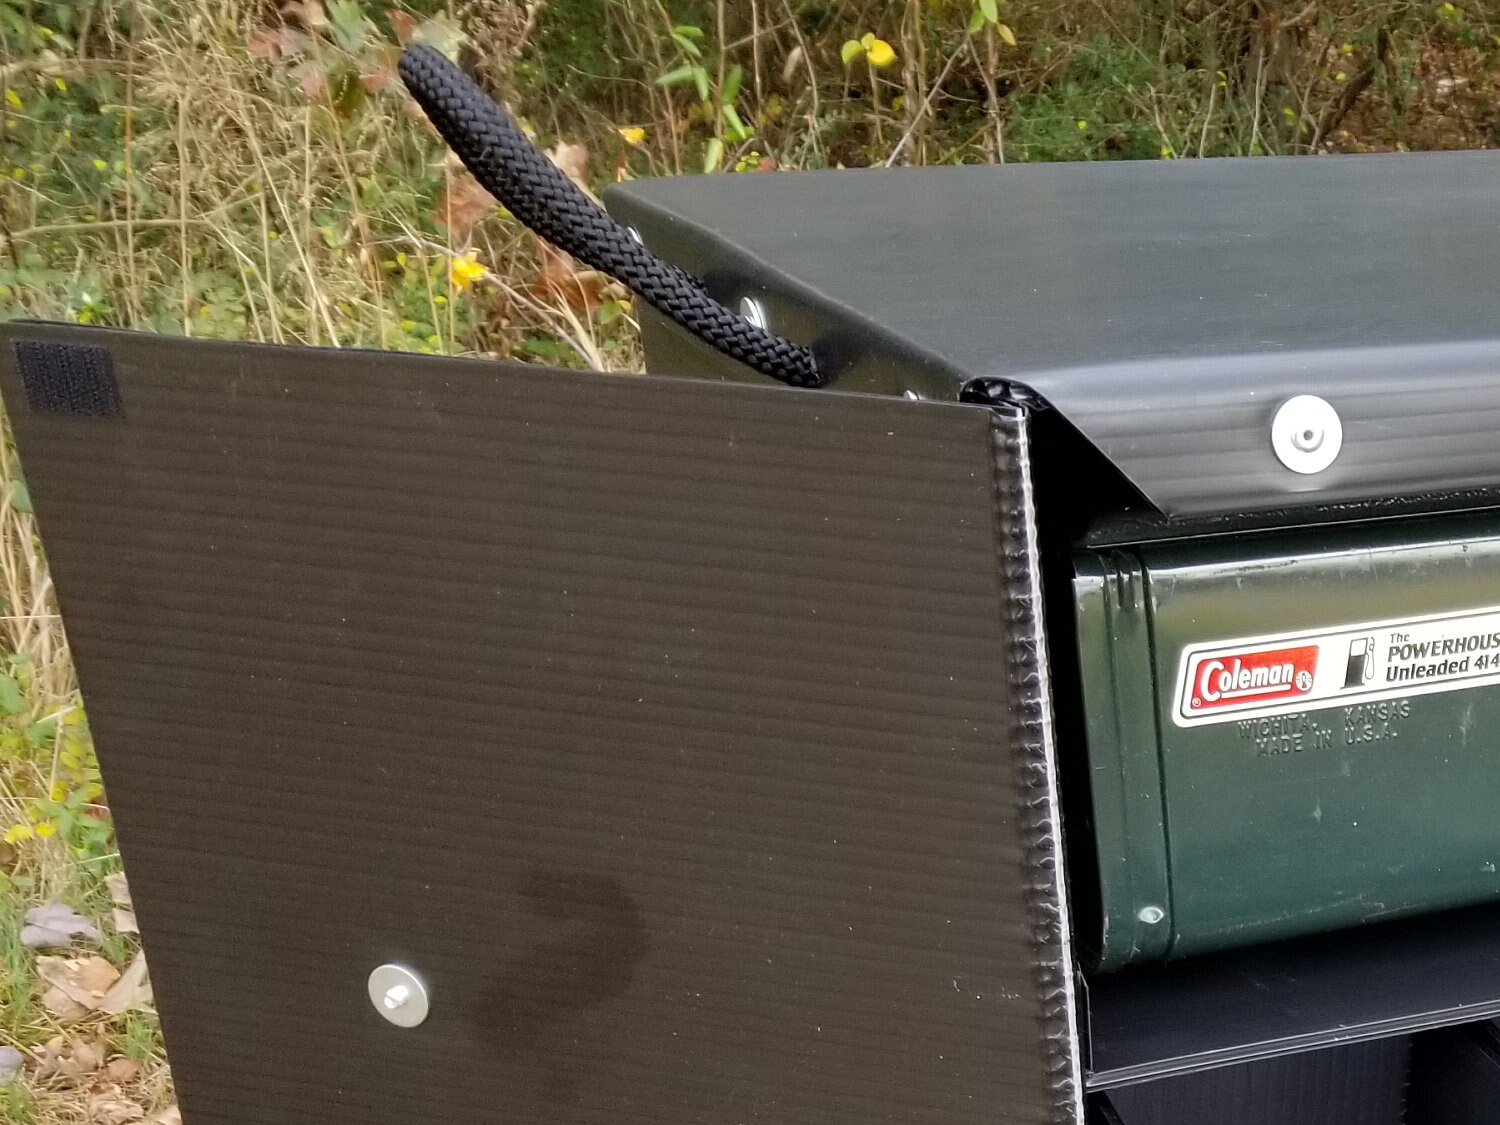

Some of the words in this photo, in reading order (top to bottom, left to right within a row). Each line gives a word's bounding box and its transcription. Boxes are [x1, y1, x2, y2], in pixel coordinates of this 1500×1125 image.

[1390, 632, 1410, 644] The
[1201, 661, 1294, 702] Coleman
[1385, 656, 1470, 683] Unleaded
[1473, 653, 1500, 671] 414
[1344, 699, 1411, 727] KANSAS
[1255, 733, 1304, 757] MADE
[1315, 729, 1334, 750] IN
